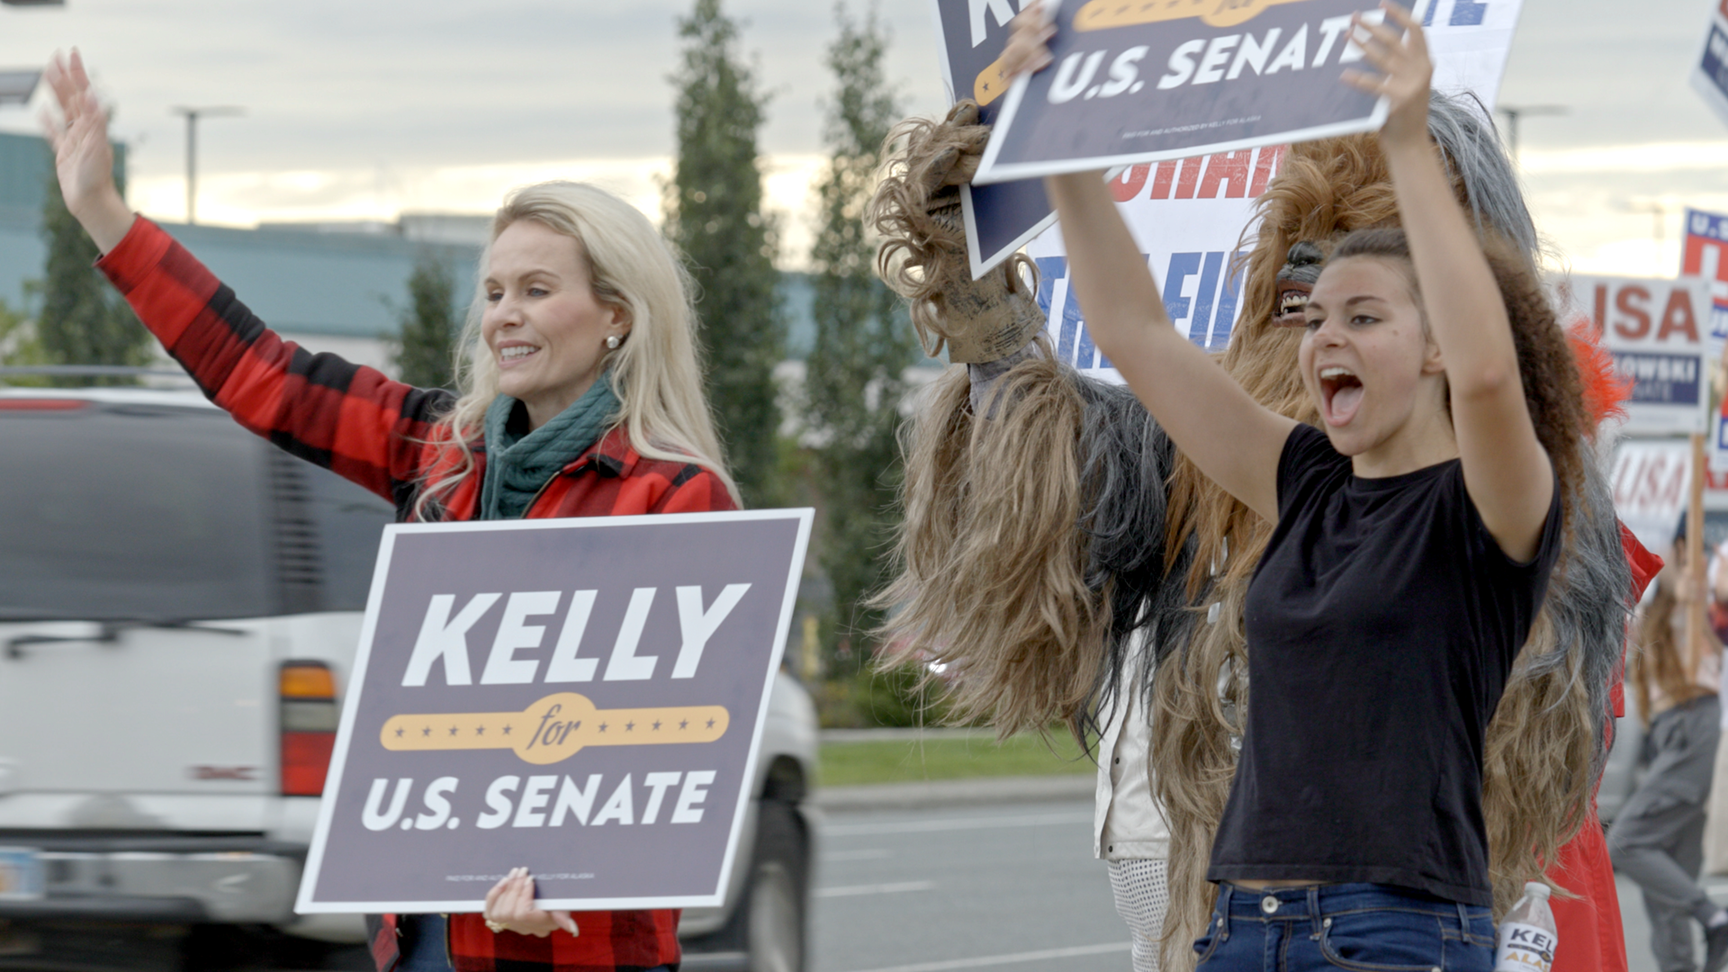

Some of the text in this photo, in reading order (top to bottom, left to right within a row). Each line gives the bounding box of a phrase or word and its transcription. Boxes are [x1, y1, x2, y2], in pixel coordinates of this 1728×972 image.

[1047, 46, 1150, 104] U.S.
[1558, 282, 1700, 342] ISA
[1613, 455, 1686, 506] LISA
[401, 583, 752, 687] KELLY
[526, 704, 581, 750] for
[361, 770, 717, 831] U.S. SENATE
